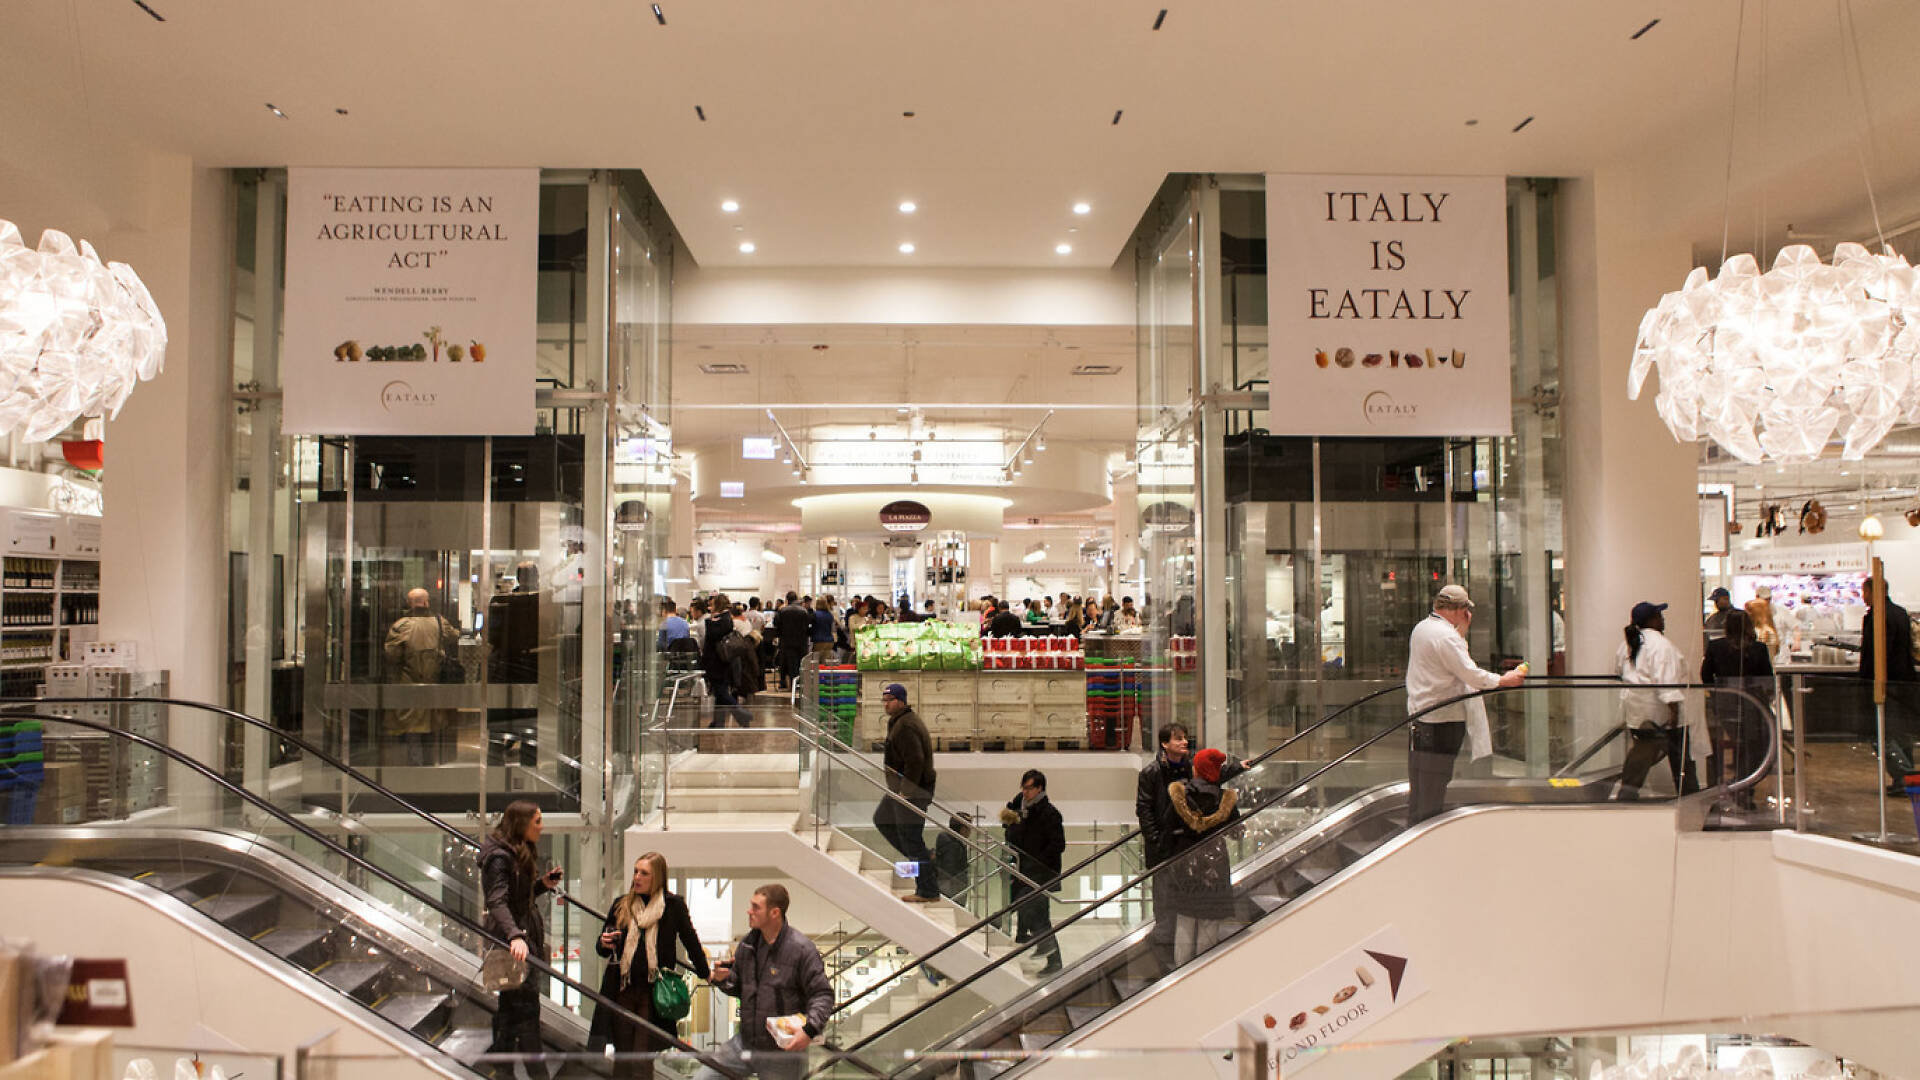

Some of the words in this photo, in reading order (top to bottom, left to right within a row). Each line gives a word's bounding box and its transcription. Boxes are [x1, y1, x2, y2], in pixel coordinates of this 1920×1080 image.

[323, 193, 423, 213] "EATING
[433, 196, 451, 213] IS
[459, 196, 493, 213] AN
[1325, 192, 1449, 223] ITALY
[317, 223, 508, 241] AGRICULTURAL
[387, 249, 449, 269] ACT"
[1369, 240, 1406, 271] IS
[374, 287, 418, 295] WENDELL
[421, 287, 449, 295] BERRY
[1307, 288, 1472, 320] EATALY
[386, 392, 438, 401] EATALY
[1368, 404, 1418, 413] EATALY
[1319, 1003, 1369, 1038] FLOOR
